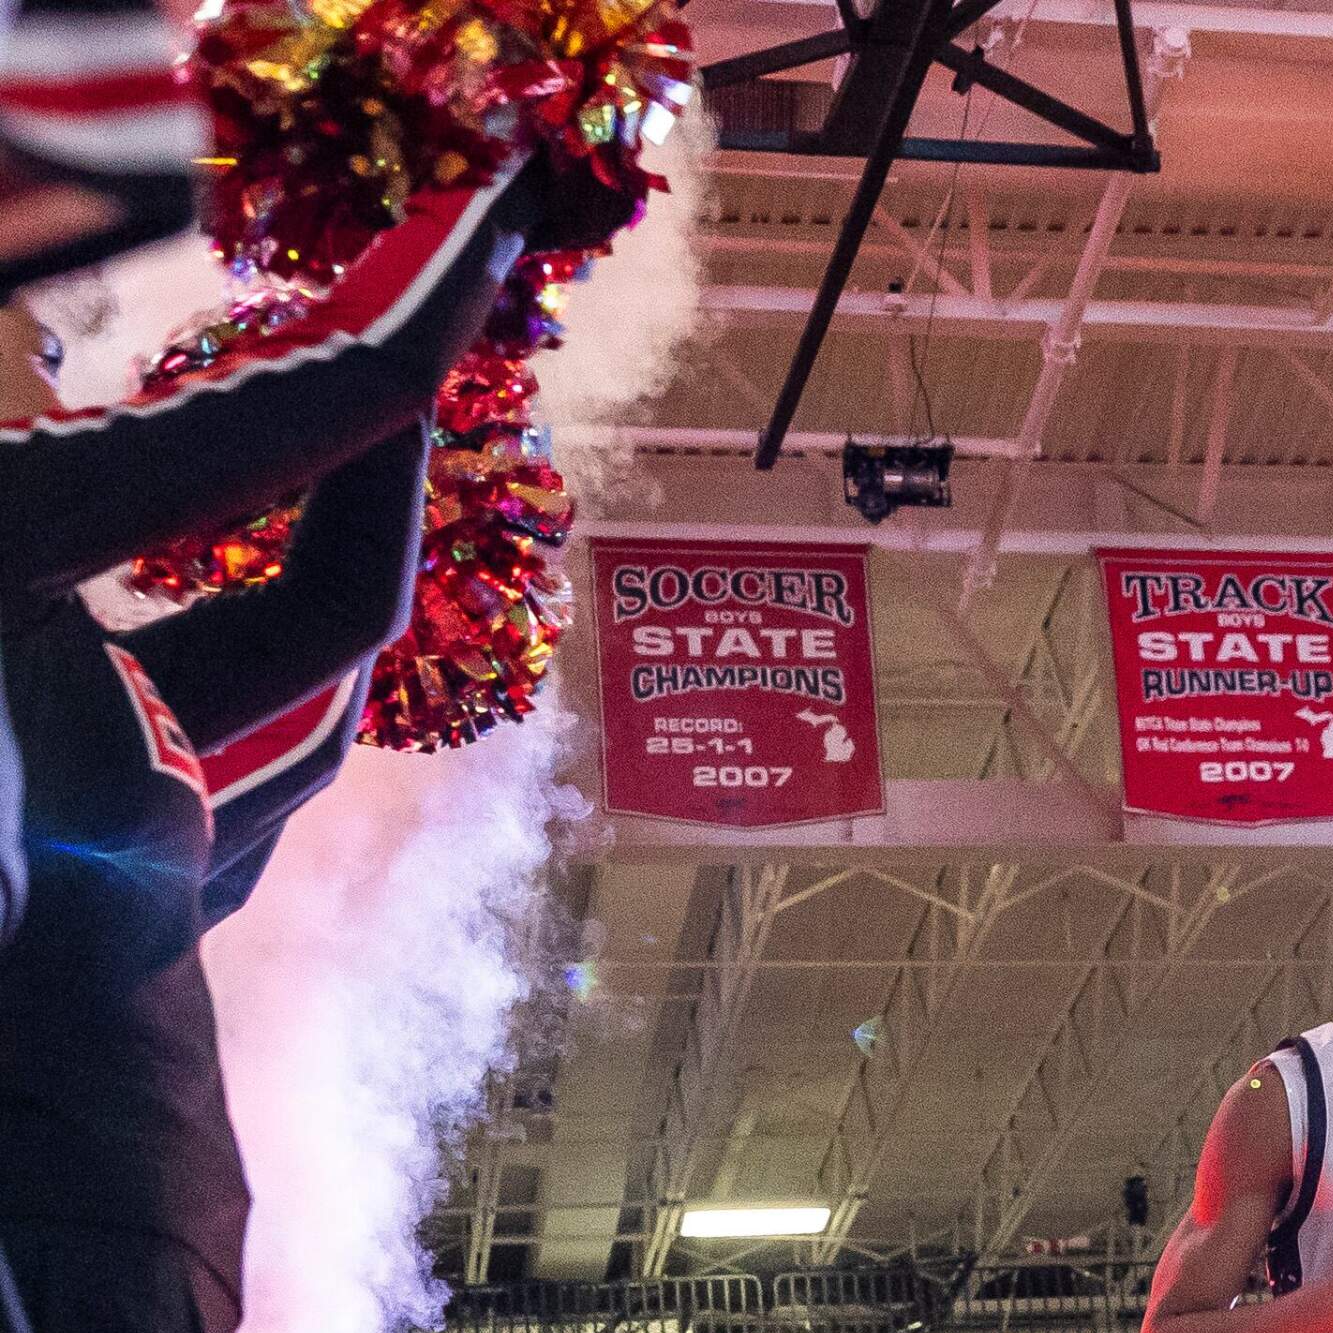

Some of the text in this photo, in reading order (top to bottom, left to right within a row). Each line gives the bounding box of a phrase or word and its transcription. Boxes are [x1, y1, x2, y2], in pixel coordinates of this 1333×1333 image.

[612, 566, 856, 628] SOCCER
[704, 610, 763, 624] BOYS
[632, 626, 837, 660] STATE
[1137, 631, 1332, 664] STATE
[630, 663, 847, 706] CHAMPIONS
[654, 718, 743, 734] RECORD:
[645, 737, 754, 756] 25-1-1
[692, 766, 794, 788] 2007
[1199, 761, 1296, 783] 2007
